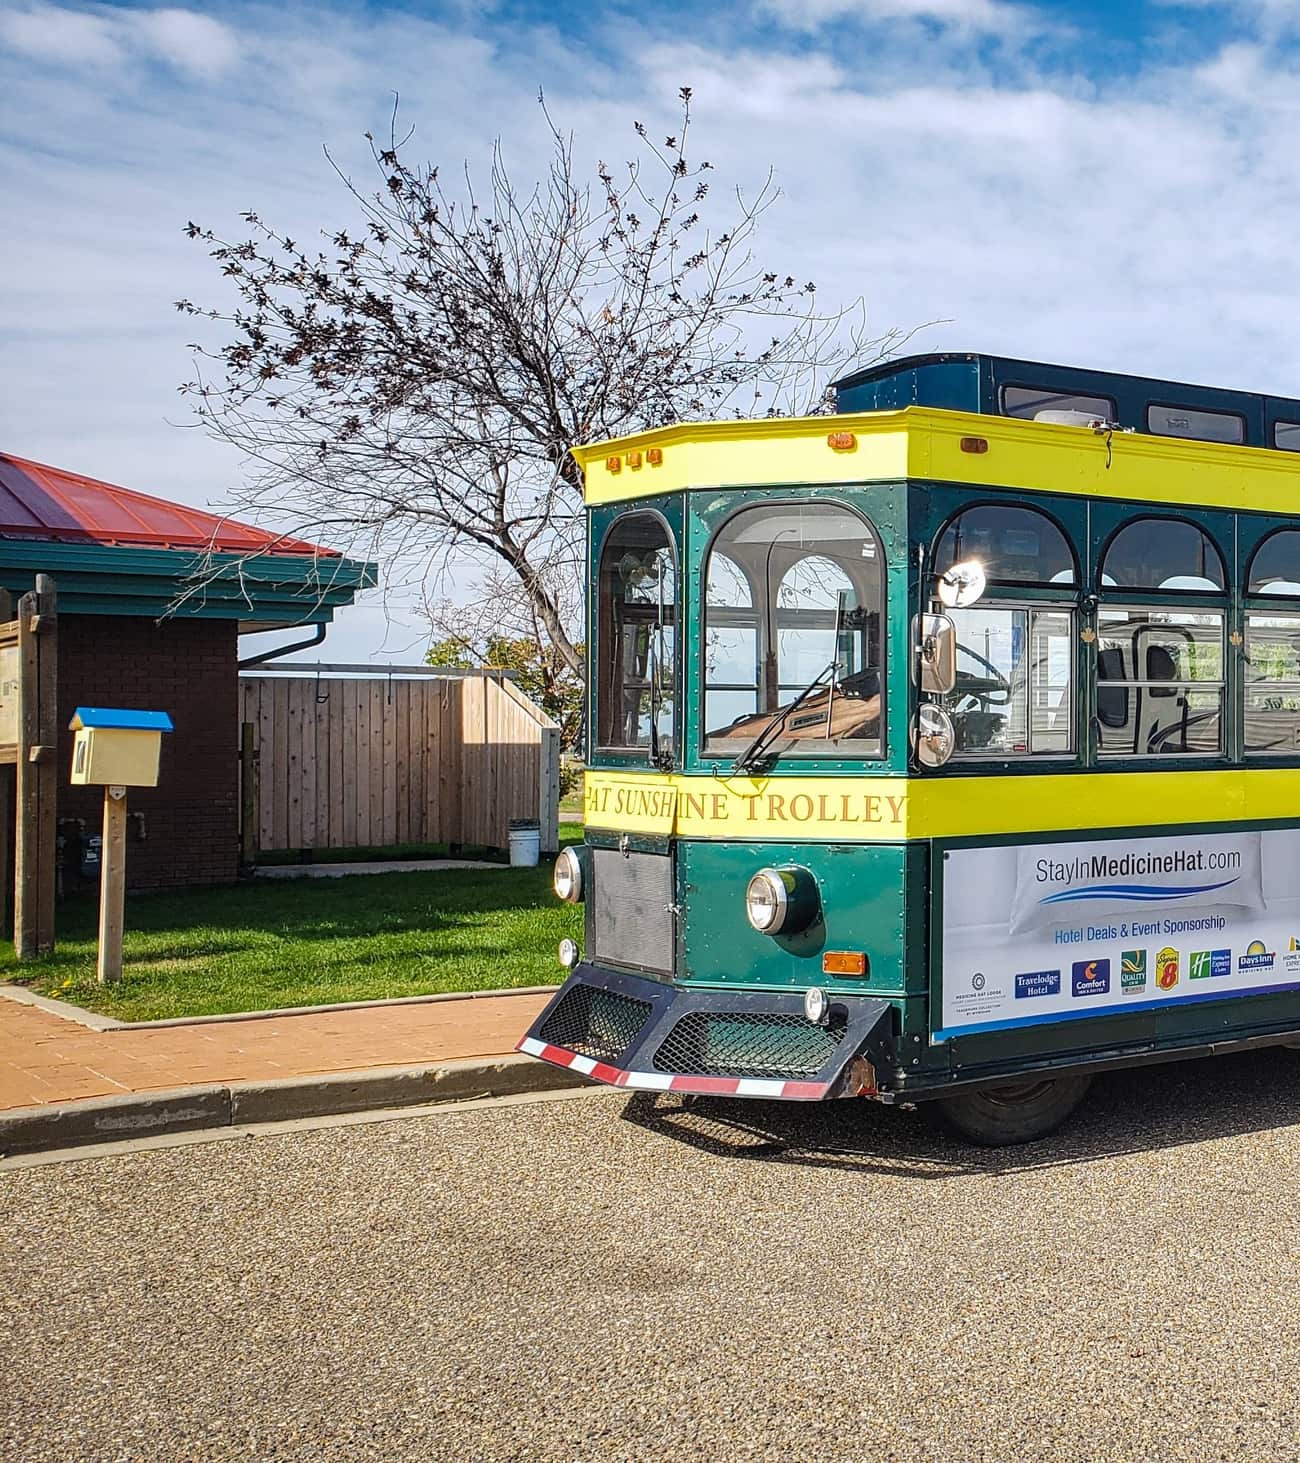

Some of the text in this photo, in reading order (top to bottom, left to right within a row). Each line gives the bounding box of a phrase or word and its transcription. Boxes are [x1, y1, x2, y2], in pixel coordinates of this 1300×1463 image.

[615, 788, 728, 820] SUNSHINE
[746, 793, 910, 823] TROLLEY
[1035, 850, 1241, 885] StayInMedicineHat.com
[1055, 915, 1225, 944] Hotel Deals & Event Sponsorship
[1240, 957, 1258, 965] Days
[1259, 955, 1272, 963] Inn
[1017, 974, 1058, 986] Travelodge
[1076, 979, 1106, 989] Comfort
[1161, 963, 1177, 987] 8
[1028, 986, 1048, 995] Hotel
